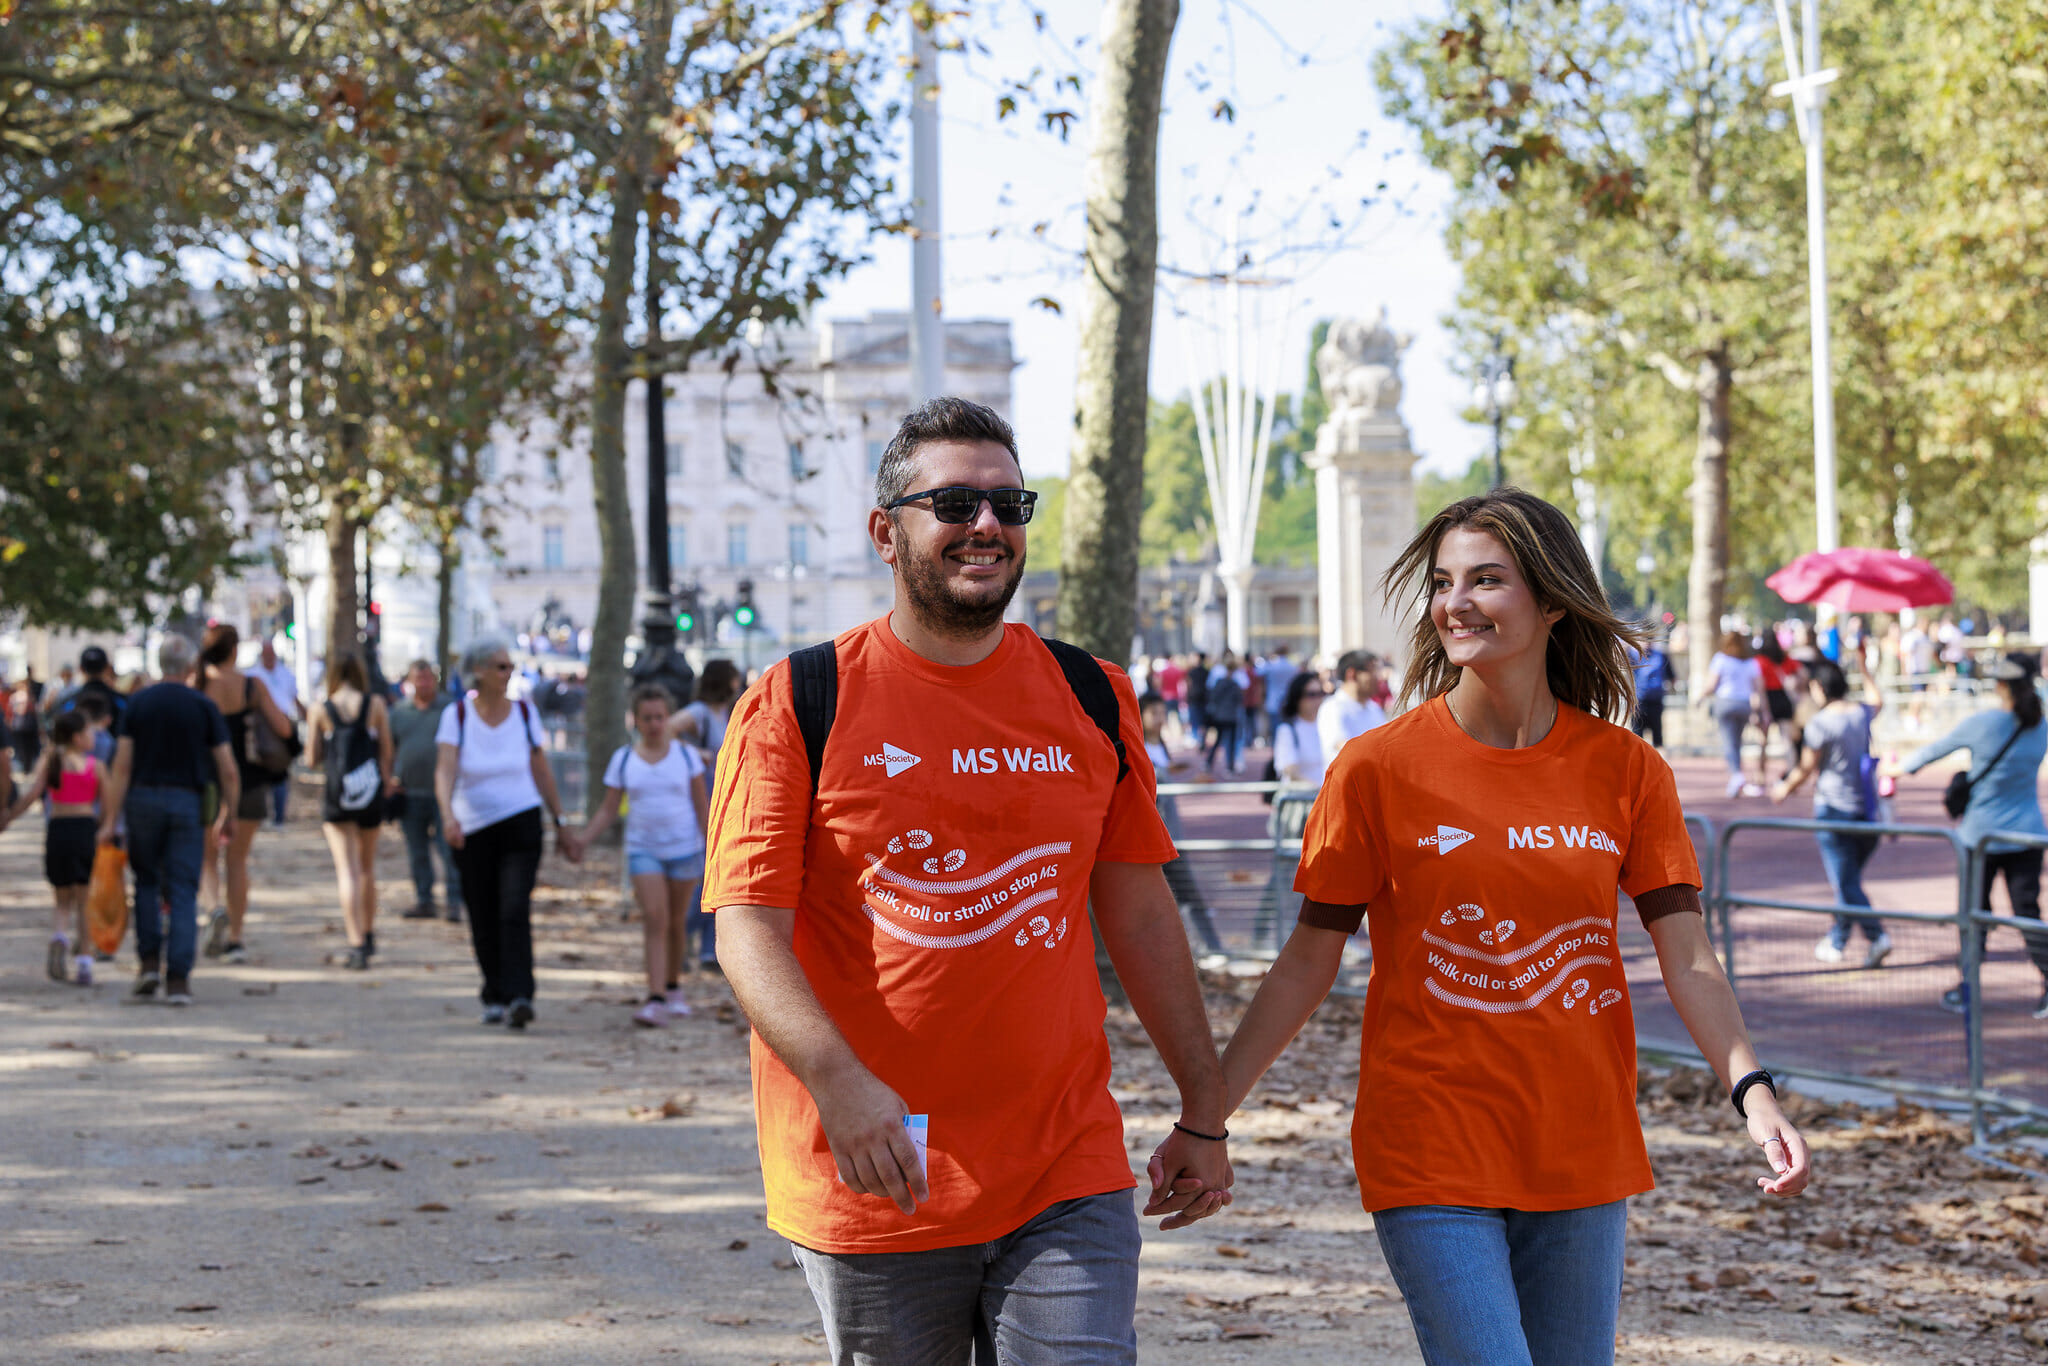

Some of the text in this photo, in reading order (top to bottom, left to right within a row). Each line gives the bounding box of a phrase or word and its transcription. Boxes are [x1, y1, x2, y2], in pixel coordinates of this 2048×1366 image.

[864, 754, 915, 766] MS Society
[952, 746, 1074, 774] MS Walk
[1418, 832, 1469, 847] MS Society
[1508, 826, 1620, 855] MS Walk
[863, 864, 1058, 922] Walk, roll or stroll to stop MS
[1427, 933, 1609, 990] Walk, roll or stroll to stop MS
